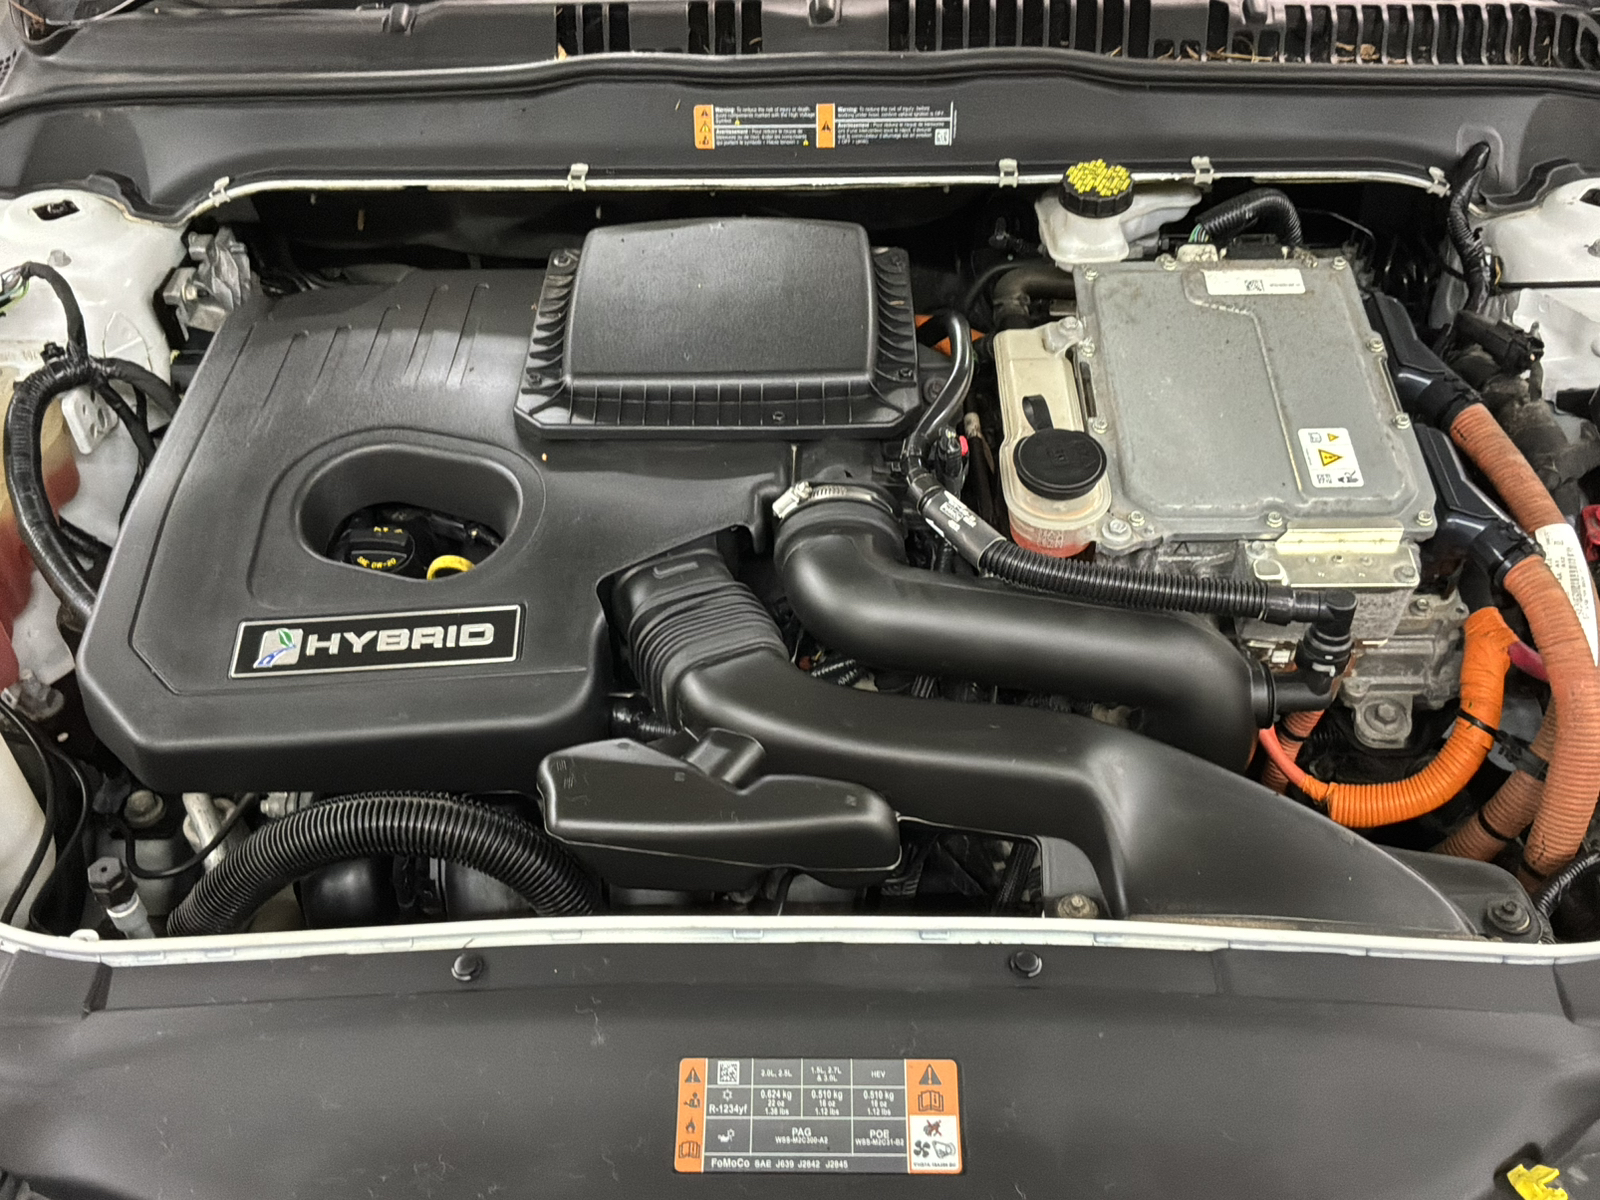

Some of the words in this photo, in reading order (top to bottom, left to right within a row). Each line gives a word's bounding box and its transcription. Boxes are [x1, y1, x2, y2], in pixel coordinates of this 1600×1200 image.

[305, 623, 495, 656] HYBRID
[871, 1070, 886, 1078] HEV
[782, 1089, 792, 1101] kg
[833, 1089, 843, 1102] kg
[884, 1090, 895, 1102] kg
[708, 1104, 748, 1115] R-1234yf
[791, 1127, 812, 1136] PAG
[869, 1129, 890, 1138] POE
[711, 1157, 750, 1168] FoMoCo
